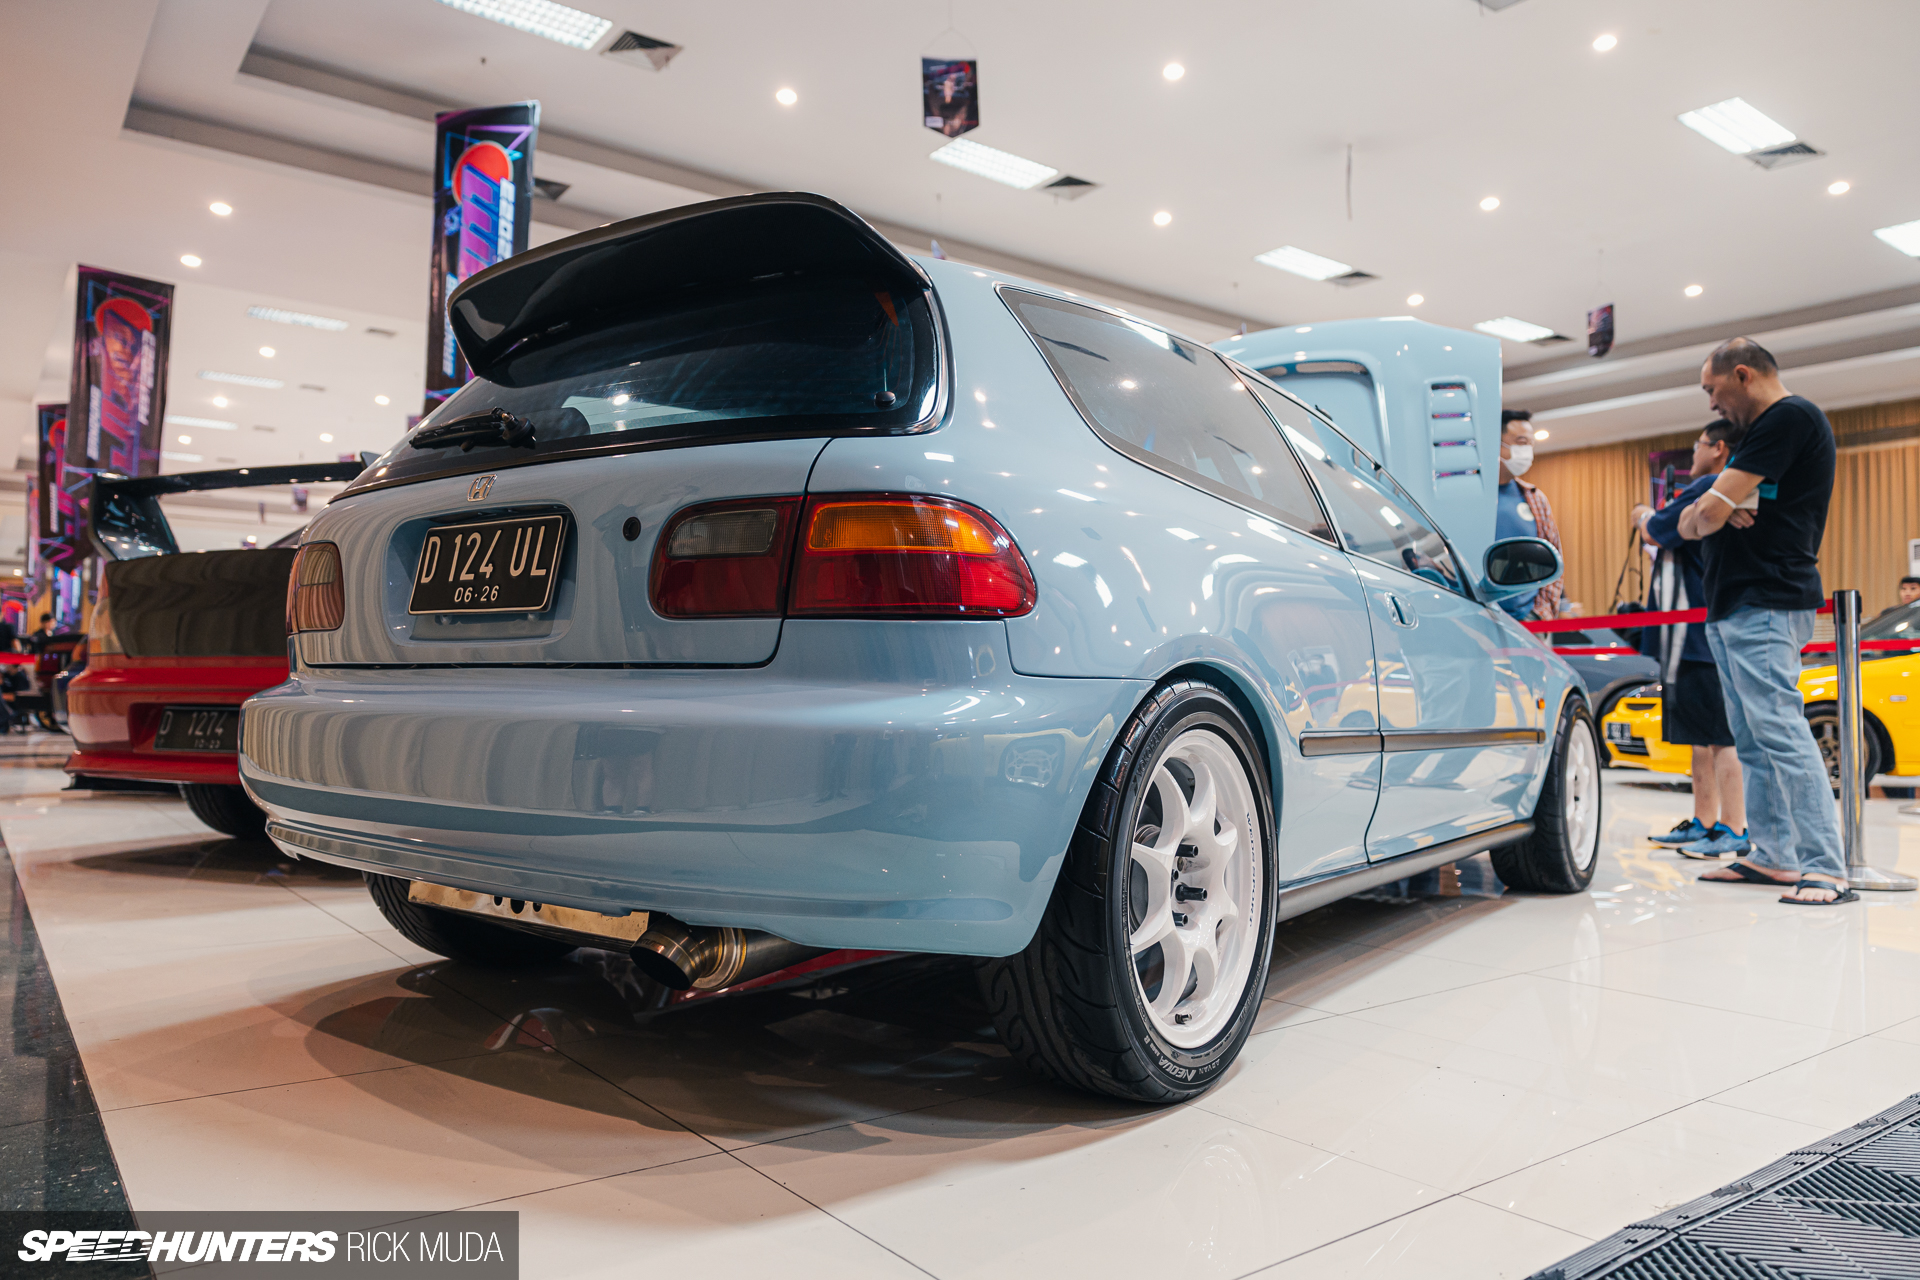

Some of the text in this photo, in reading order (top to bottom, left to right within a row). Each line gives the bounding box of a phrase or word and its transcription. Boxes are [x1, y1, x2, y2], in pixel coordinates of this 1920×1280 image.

[420, 525, 547, 584] D 124 UL
[187, 711, 228, 737] 1274
[1158, 1056, 1196, 1081] NEOVA
[1198, 1058, 1221, 1075] ADVAN
